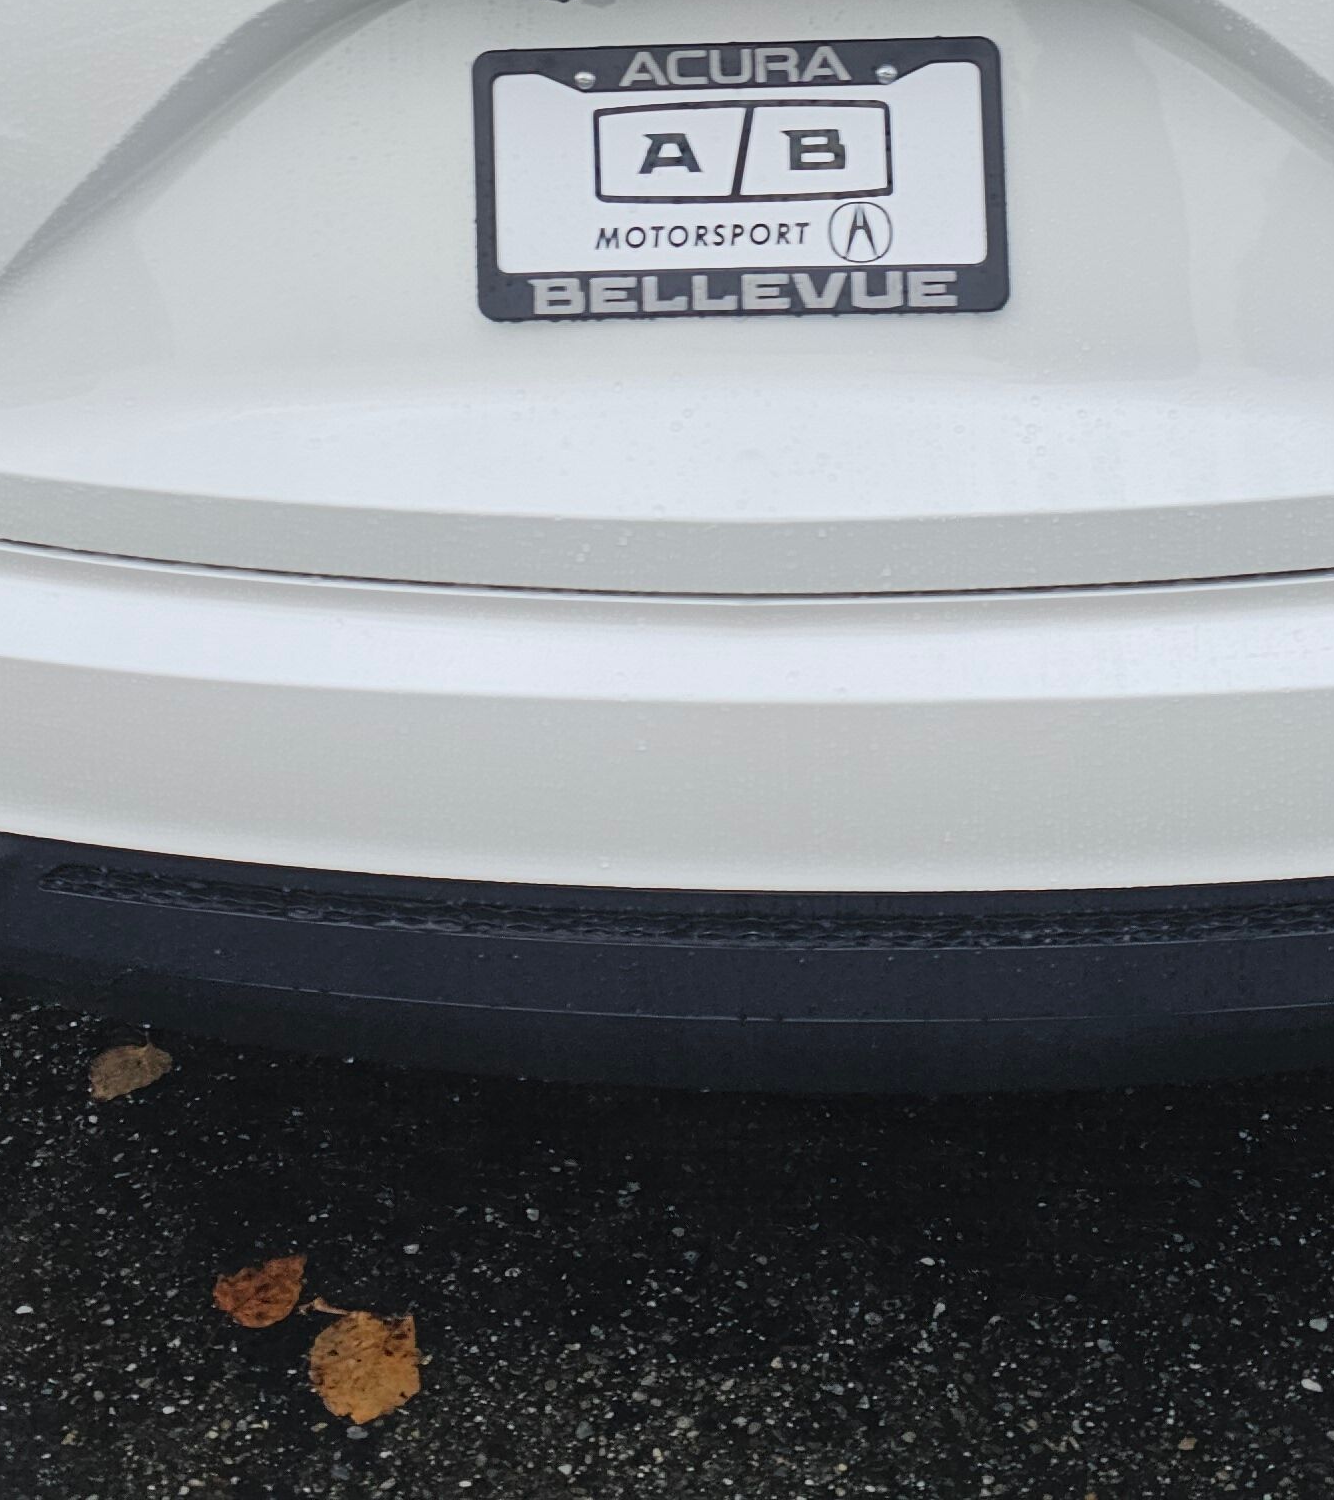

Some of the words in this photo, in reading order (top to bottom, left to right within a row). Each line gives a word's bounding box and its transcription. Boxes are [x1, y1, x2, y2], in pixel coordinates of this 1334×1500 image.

[618, 45, 852, 88] ACURA
[594, 221, 811, 250] MOTORSPORT
[527, 270, 959, 315] BELLEVUE
